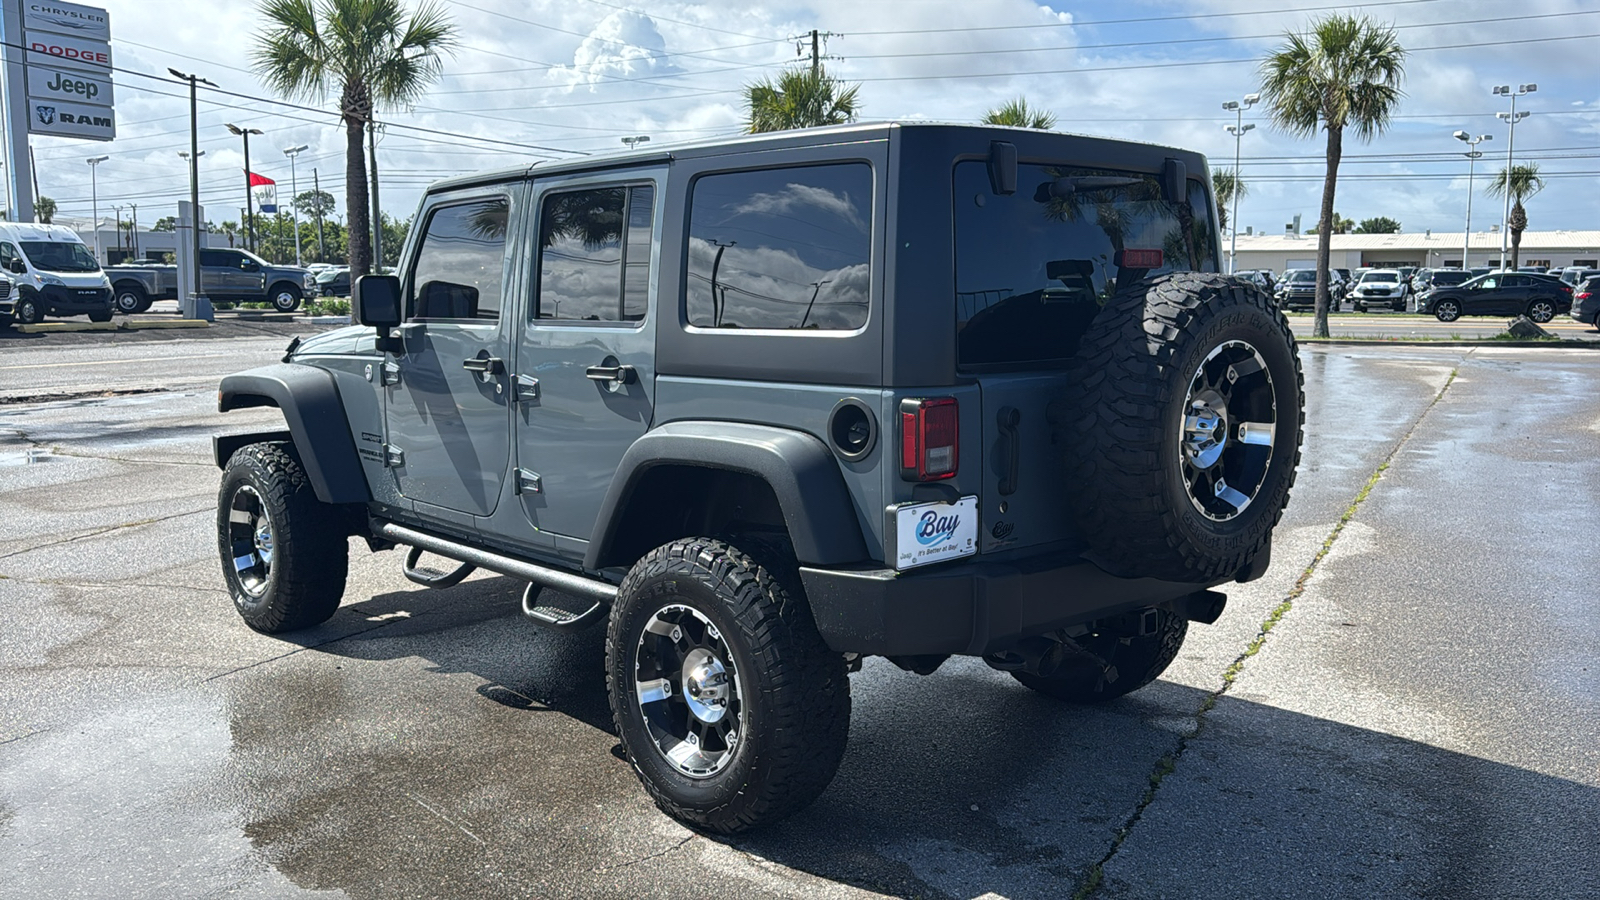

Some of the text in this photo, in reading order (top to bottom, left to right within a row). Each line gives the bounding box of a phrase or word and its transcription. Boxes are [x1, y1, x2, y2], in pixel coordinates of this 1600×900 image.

[31, 5, 104, 23] CHRYSLER
[32, 42, 108, 64] DODGE
[47, 73, 98, 99] Jeep
[60, 112, 111, 127] RAM
[918, 510, 961, 540] Bay
[926, 547, 941, 556] Better
